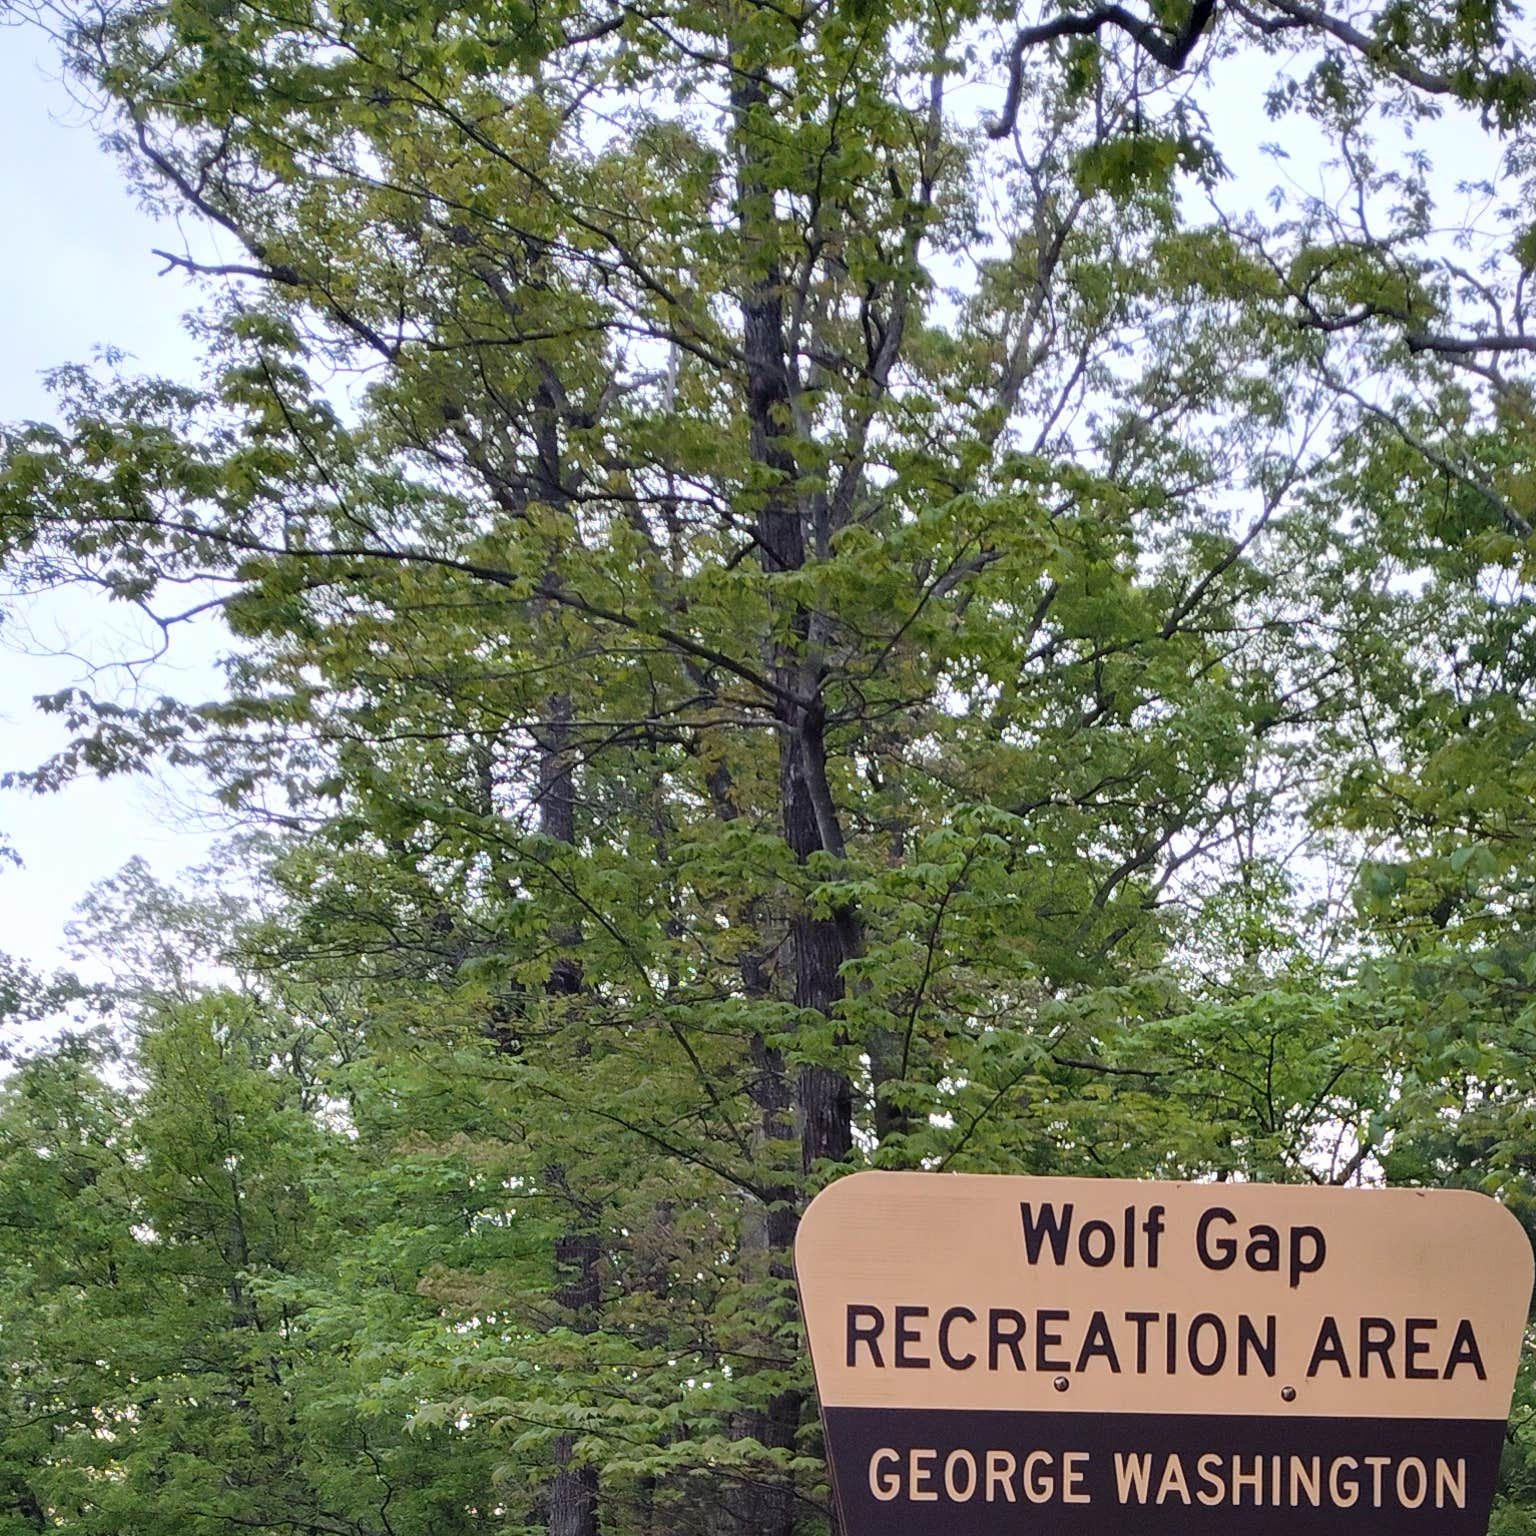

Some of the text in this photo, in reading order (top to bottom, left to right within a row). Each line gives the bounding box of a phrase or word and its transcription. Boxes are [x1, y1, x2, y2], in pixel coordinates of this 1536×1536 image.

[1020, 1202, 1327, 1287] Wolf Gap
[845, 1304, 1488, 1381] RECREATION AREA
[868, 1448, 1467, 1509] GEORGE WASHINGTON
